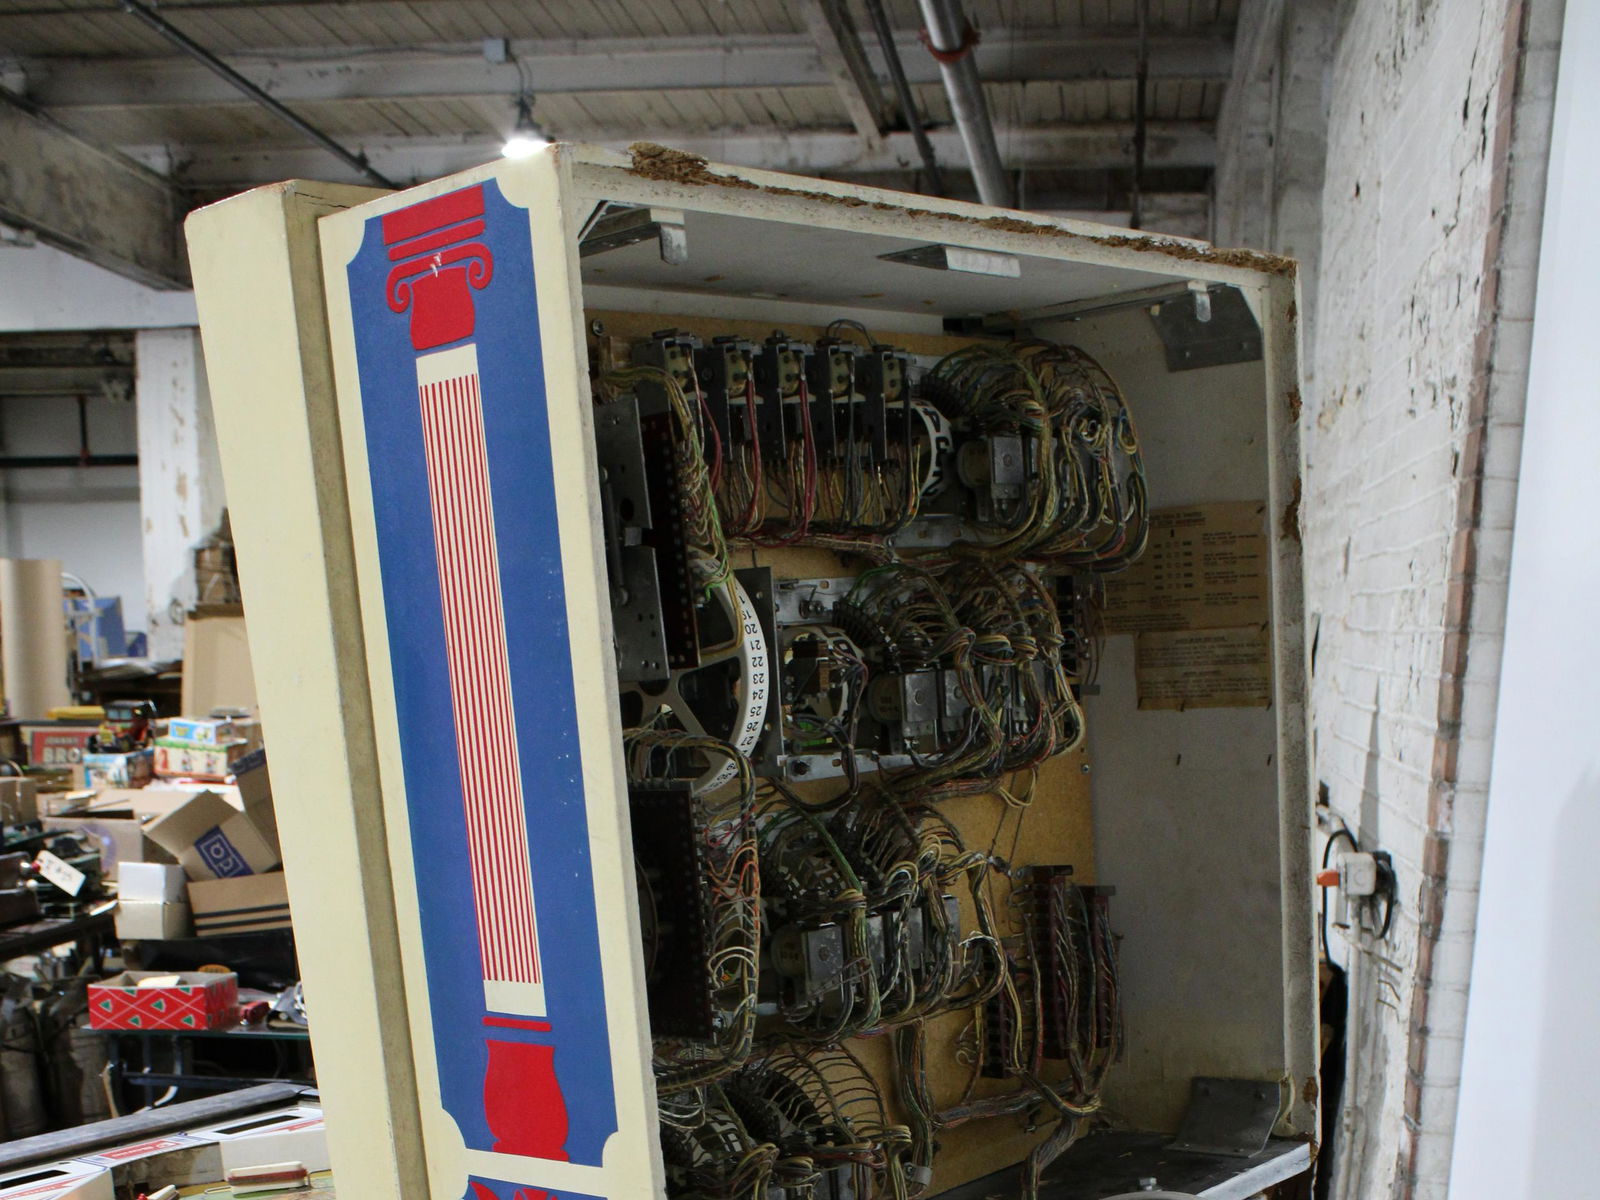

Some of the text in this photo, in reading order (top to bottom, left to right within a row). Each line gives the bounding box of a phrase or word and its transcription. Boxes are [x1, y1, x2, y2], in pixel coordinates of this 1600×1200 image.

[744, 623, 758, 635] 20
[750, 639, 762, 651] 21
[751, 656, 764, 668] 22
[752, 672, 765, 685] 23
[752, 689, 764, 701] 24
[750, 705, 762, 717] 25
[745, 721, 759, 733] 26
[740, 735, 754, 746] 27
